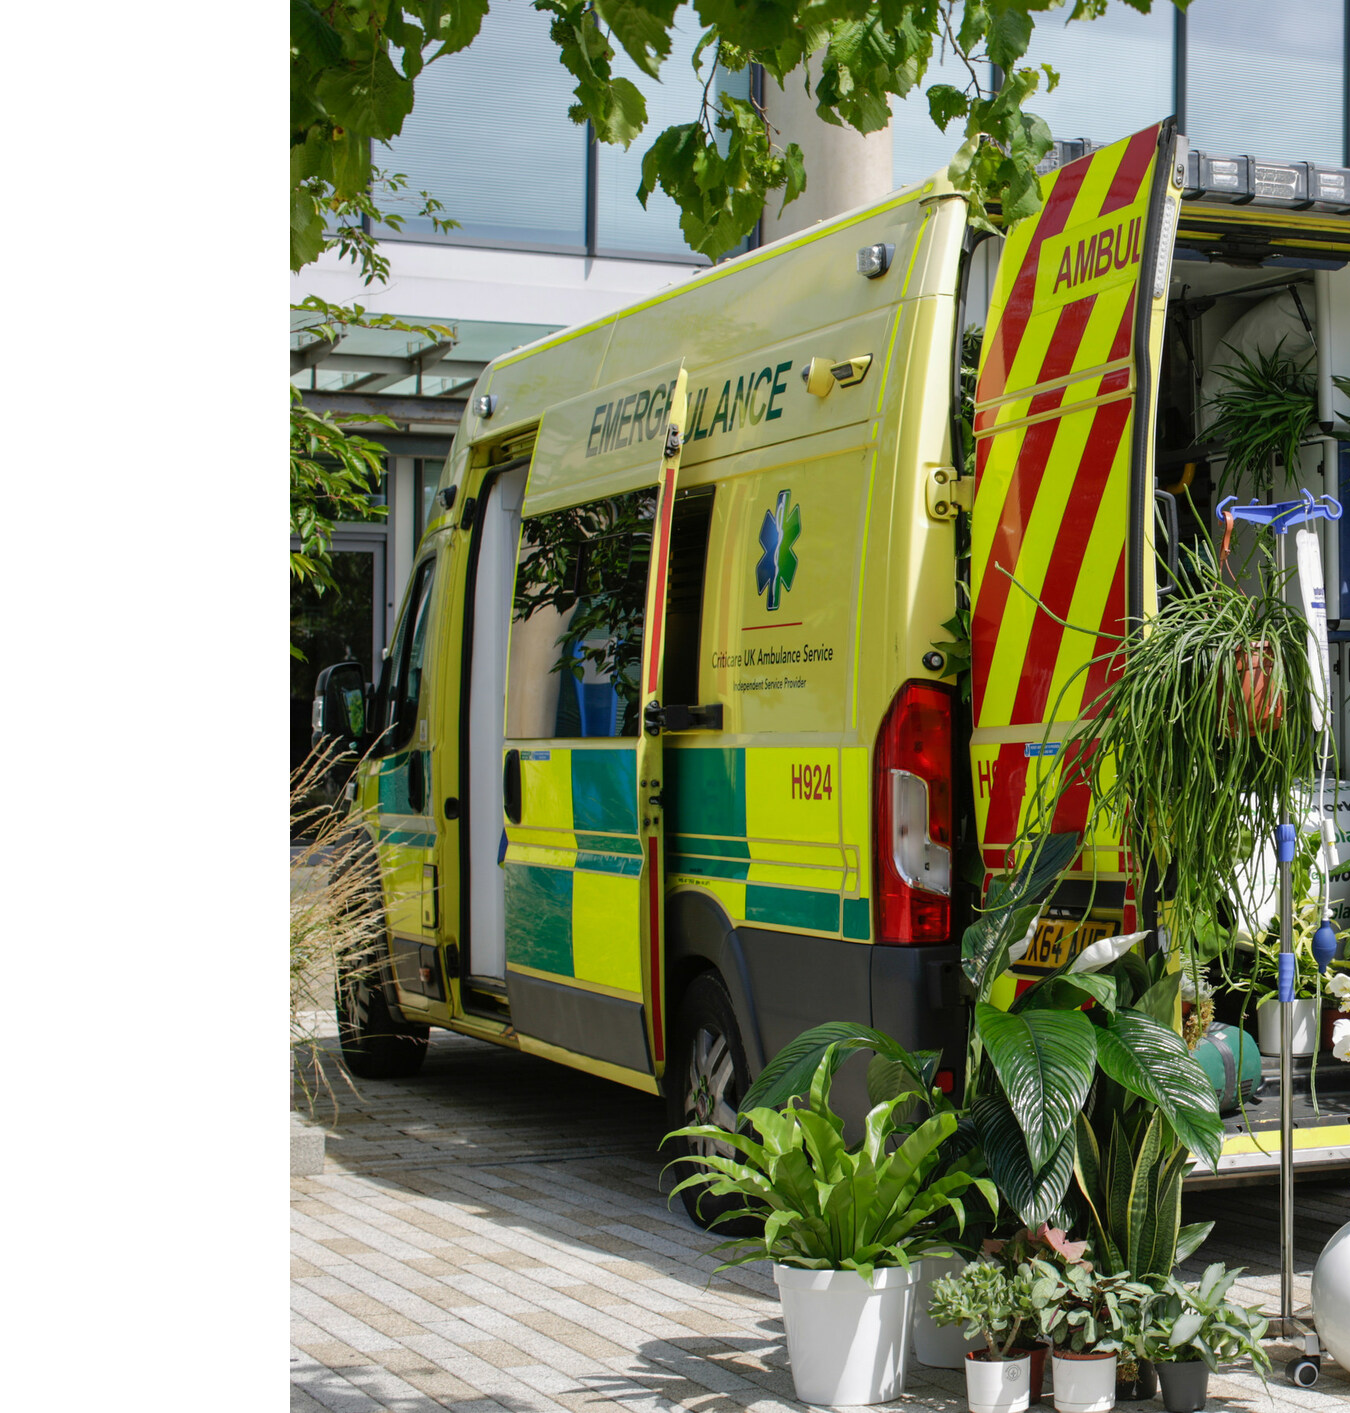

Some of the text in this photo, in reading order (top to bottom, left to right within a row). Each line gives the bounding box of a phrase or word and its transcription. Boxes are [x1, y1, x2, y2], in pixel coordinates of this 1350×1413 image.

[1053, 216, 1142, 295] AMBUL
[712, 643, 833, 669] Criticare UK Ambulance Service
[733, 676, 806, 693] Independent Service Provider
[792, 764, 832, 800] H924
[1020, 924, 1065, 963] X64
